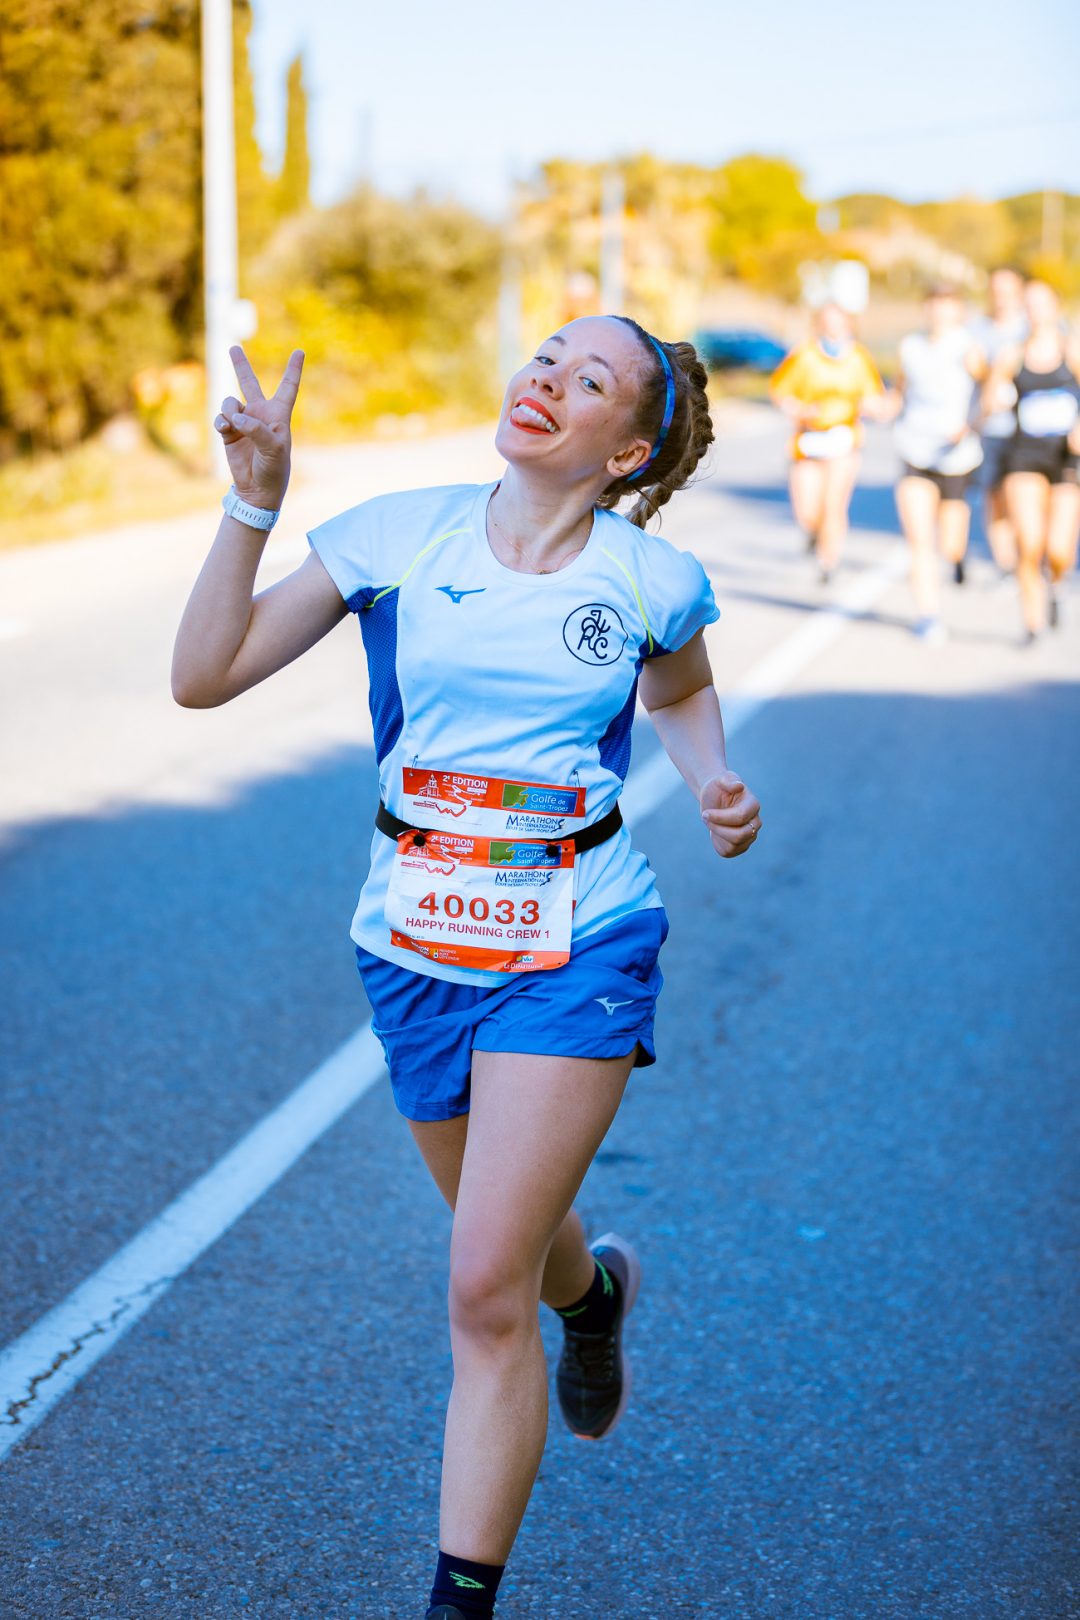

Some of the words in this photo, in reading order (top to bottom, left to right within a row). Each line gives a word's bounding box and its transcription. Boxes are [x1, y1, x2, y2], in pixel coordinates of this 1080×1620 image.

[452, 776, 488, 789] EDITION
[530, 793, 557, 804] Golfe
[530, 803, 569, 812] Saint-Tropez
[439, 836, 475, 847] EDITION
[517, 849, 544, 858] Golfe
[417, 891, 541, 926] 40033
[405, 917, 446, 931] HAPPY
[448, 922, 504, 938] RUNNING
[506, 929, 541, 940] CREW
[544, 929, 550, 939] 1
